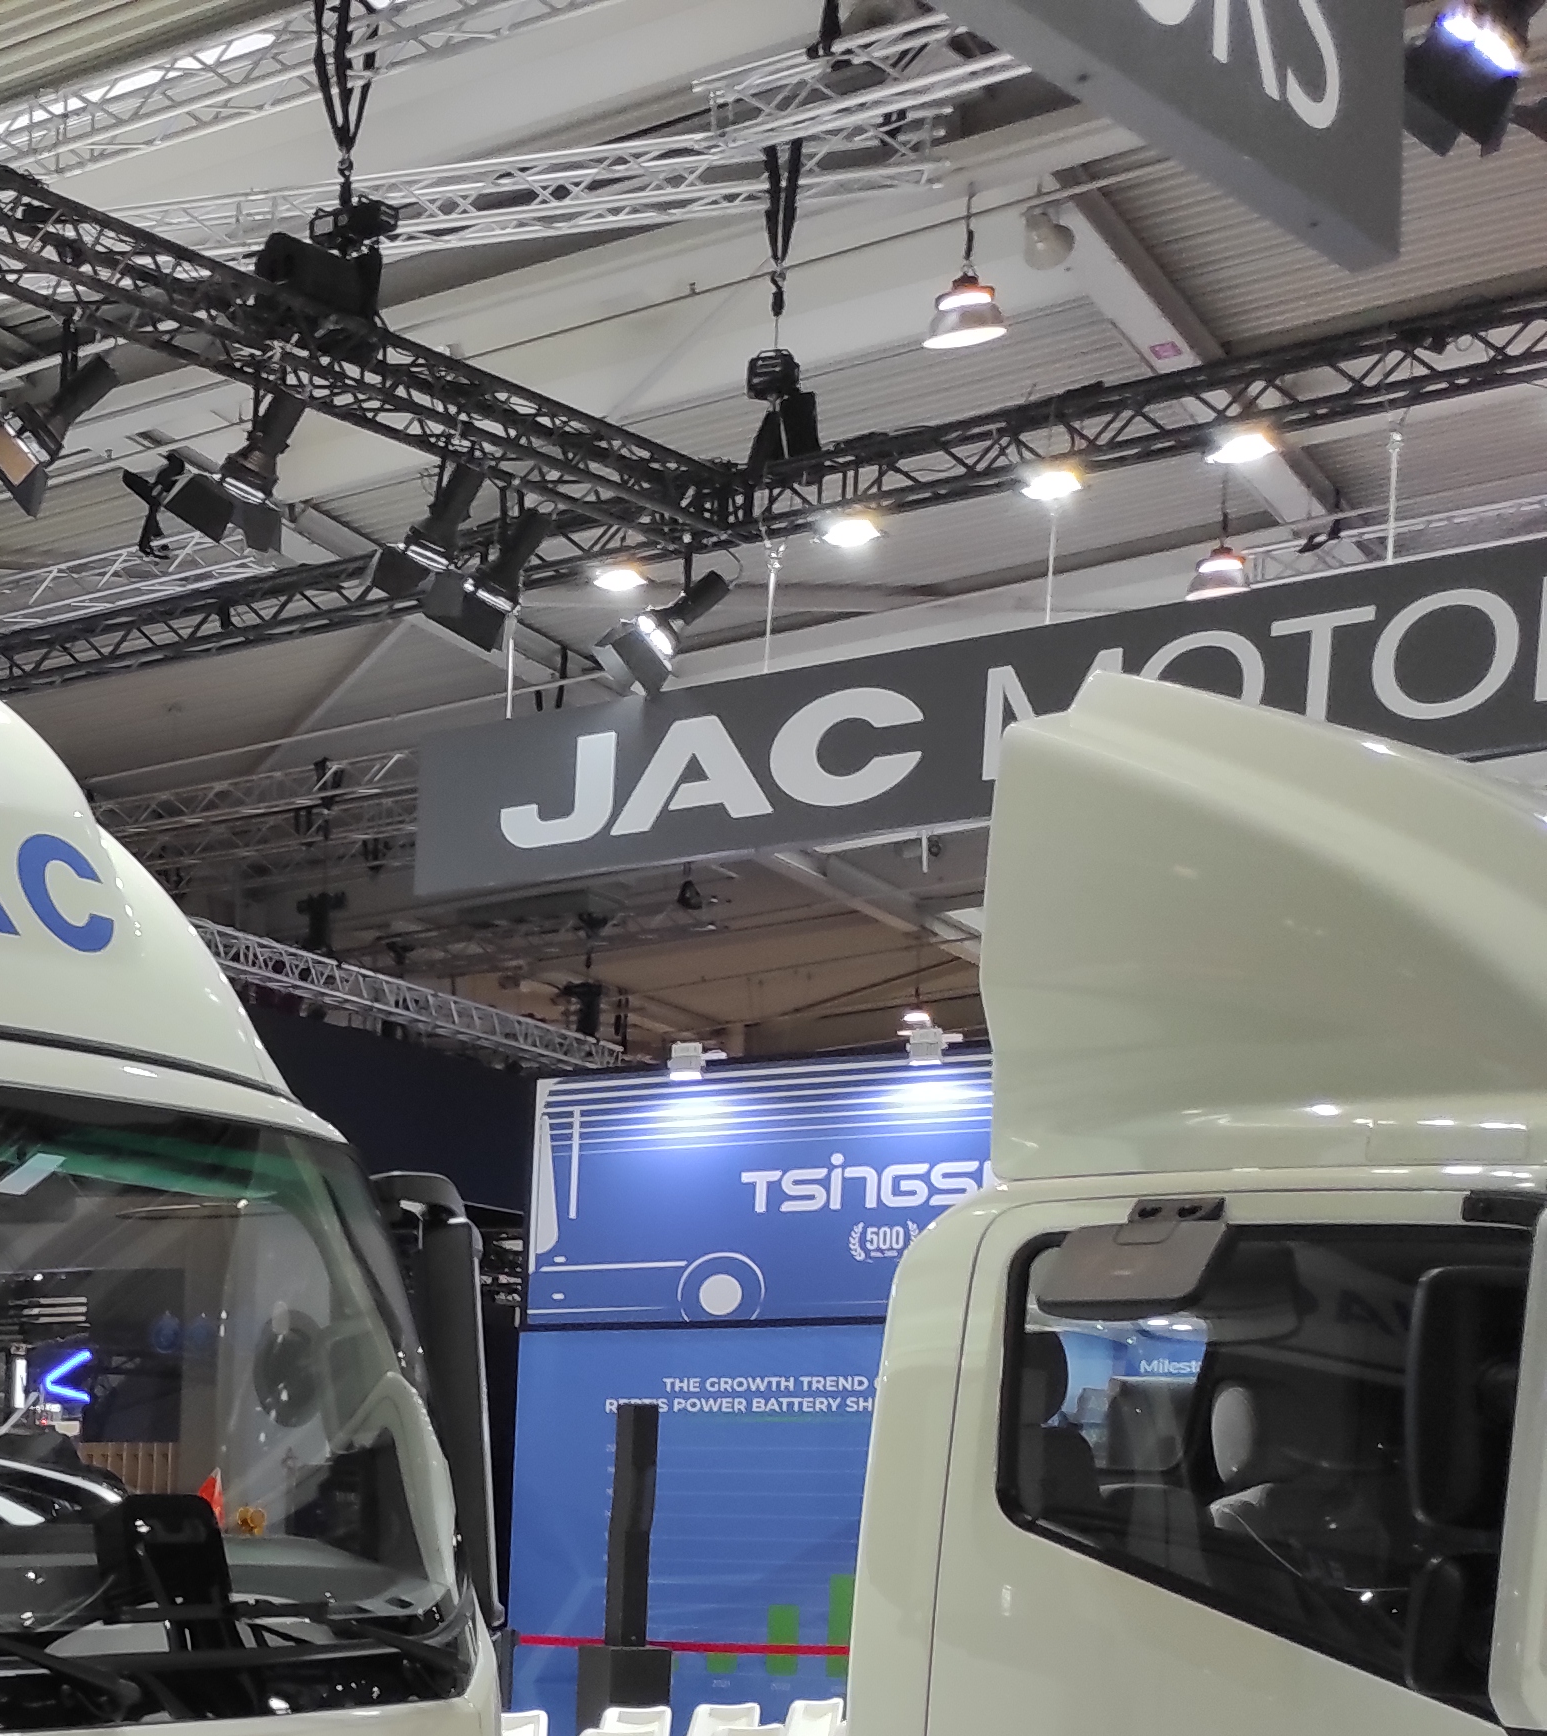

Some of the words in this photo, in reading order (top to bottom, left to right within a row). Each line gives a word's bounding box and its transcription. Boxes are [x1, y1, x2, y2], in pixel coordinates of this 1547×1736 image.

[501, 687, 924, 849] JAC
[865, 1226, 905, 1250] 500
[662, 1377, 701, 1393] THE
[705, 1376, 795, 1393] GROWTH
[799, 1375, 870, 1392] TREND
[672, 1397, 747, 1414] POWER
[752, 1397, 841, 1413] BATTERY
[845, 1397, 876, 1412] SH
